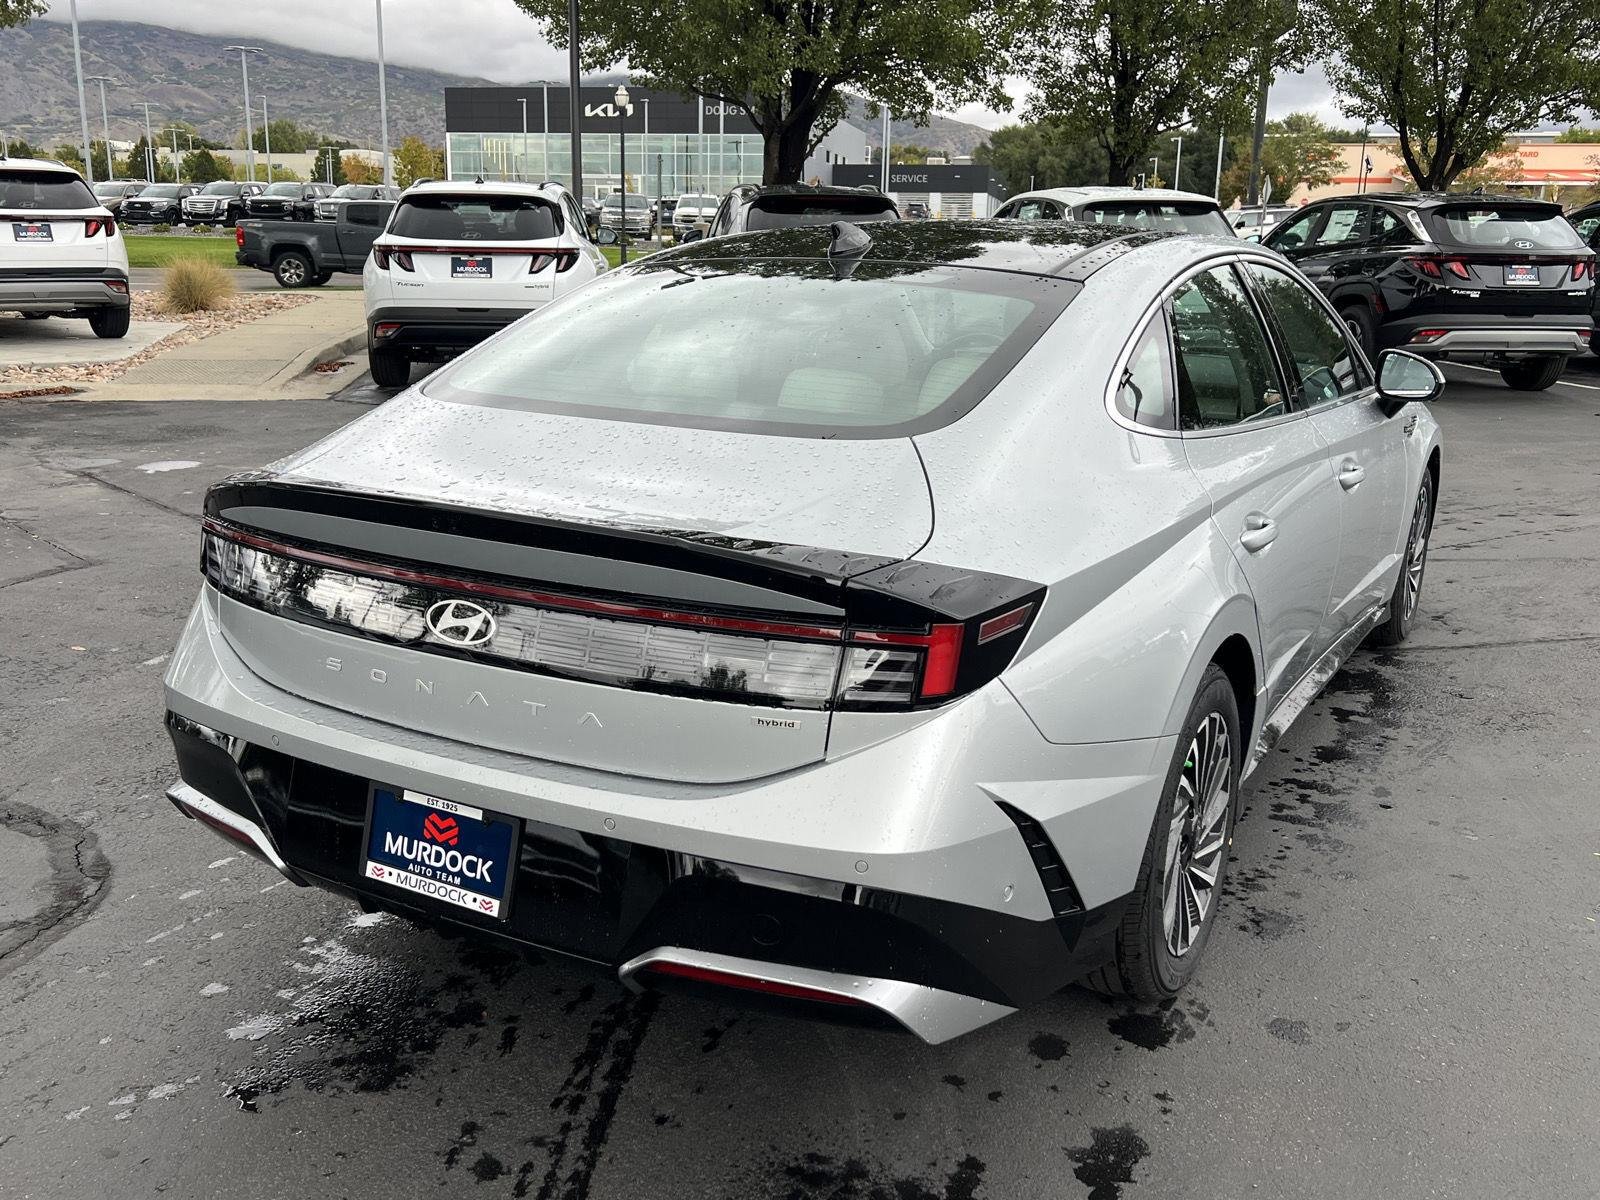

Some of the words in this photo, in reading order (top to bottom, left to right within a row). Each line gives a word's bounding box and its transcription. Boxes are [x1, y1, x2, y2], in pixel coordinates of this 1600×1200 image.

[891, 174, 928, 183] SERVICE
[325, 657, 603, 728] SONATA
[757, 718, 795, 728] hybrid
[426, 797, 441, 808] EST.
[441, 801, 458, 812] 1925
[384, 831, 494, 883] MURDOCK
[408, 862, 433, 877] AUTO
[436, 870, 461, 886] TEAM
[396, 872, 468, 905] MURDOCK
